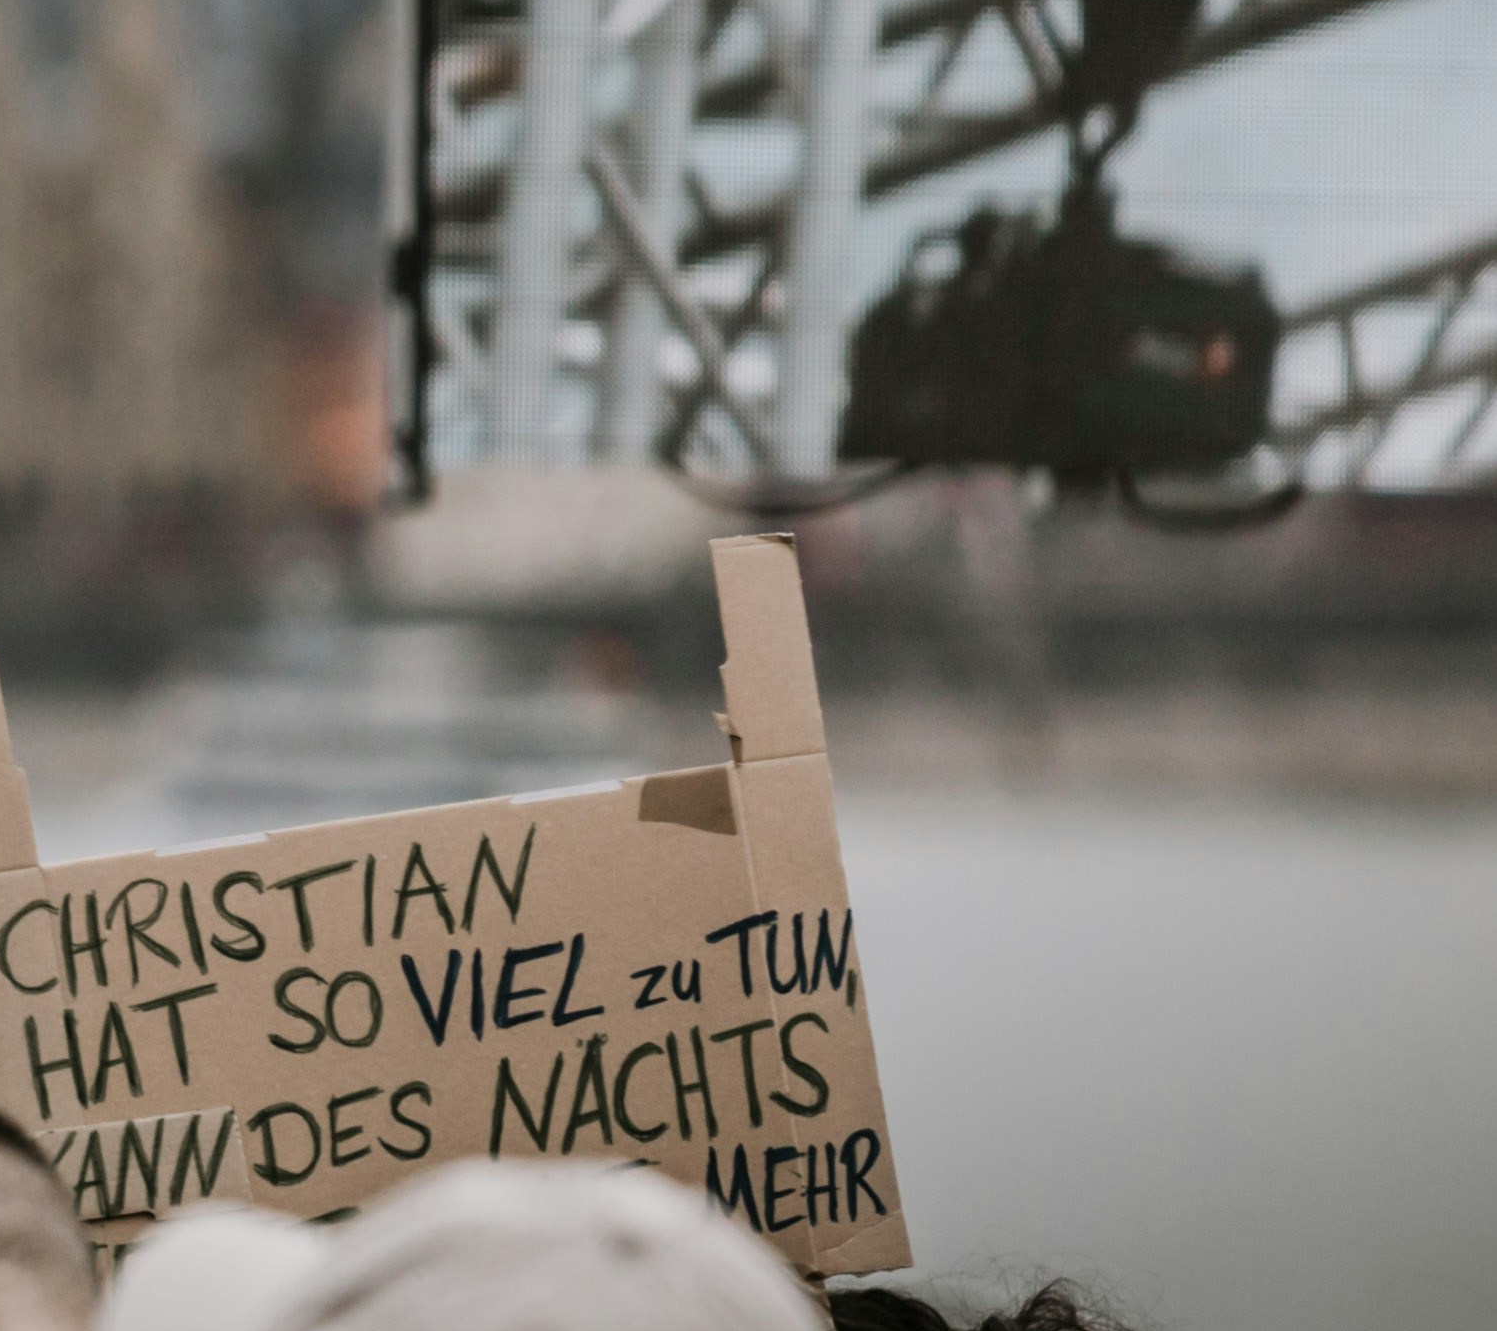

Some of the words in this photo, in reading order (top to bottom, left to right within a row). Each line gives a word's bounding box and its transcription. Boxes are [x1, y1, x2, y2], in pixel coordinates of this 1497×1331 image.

[24, 983, 218, 1120] HAT
[268, 967, 383, 1054] SO
[400, 933, 605, 1048] VIEL
[630, 958, 701, 1009] zu
[247, 1080, 432, 1186] DES
[489, 1011, 830, 1160] NÄCHTS
[706, 1127, 887, 1234] MEHR
